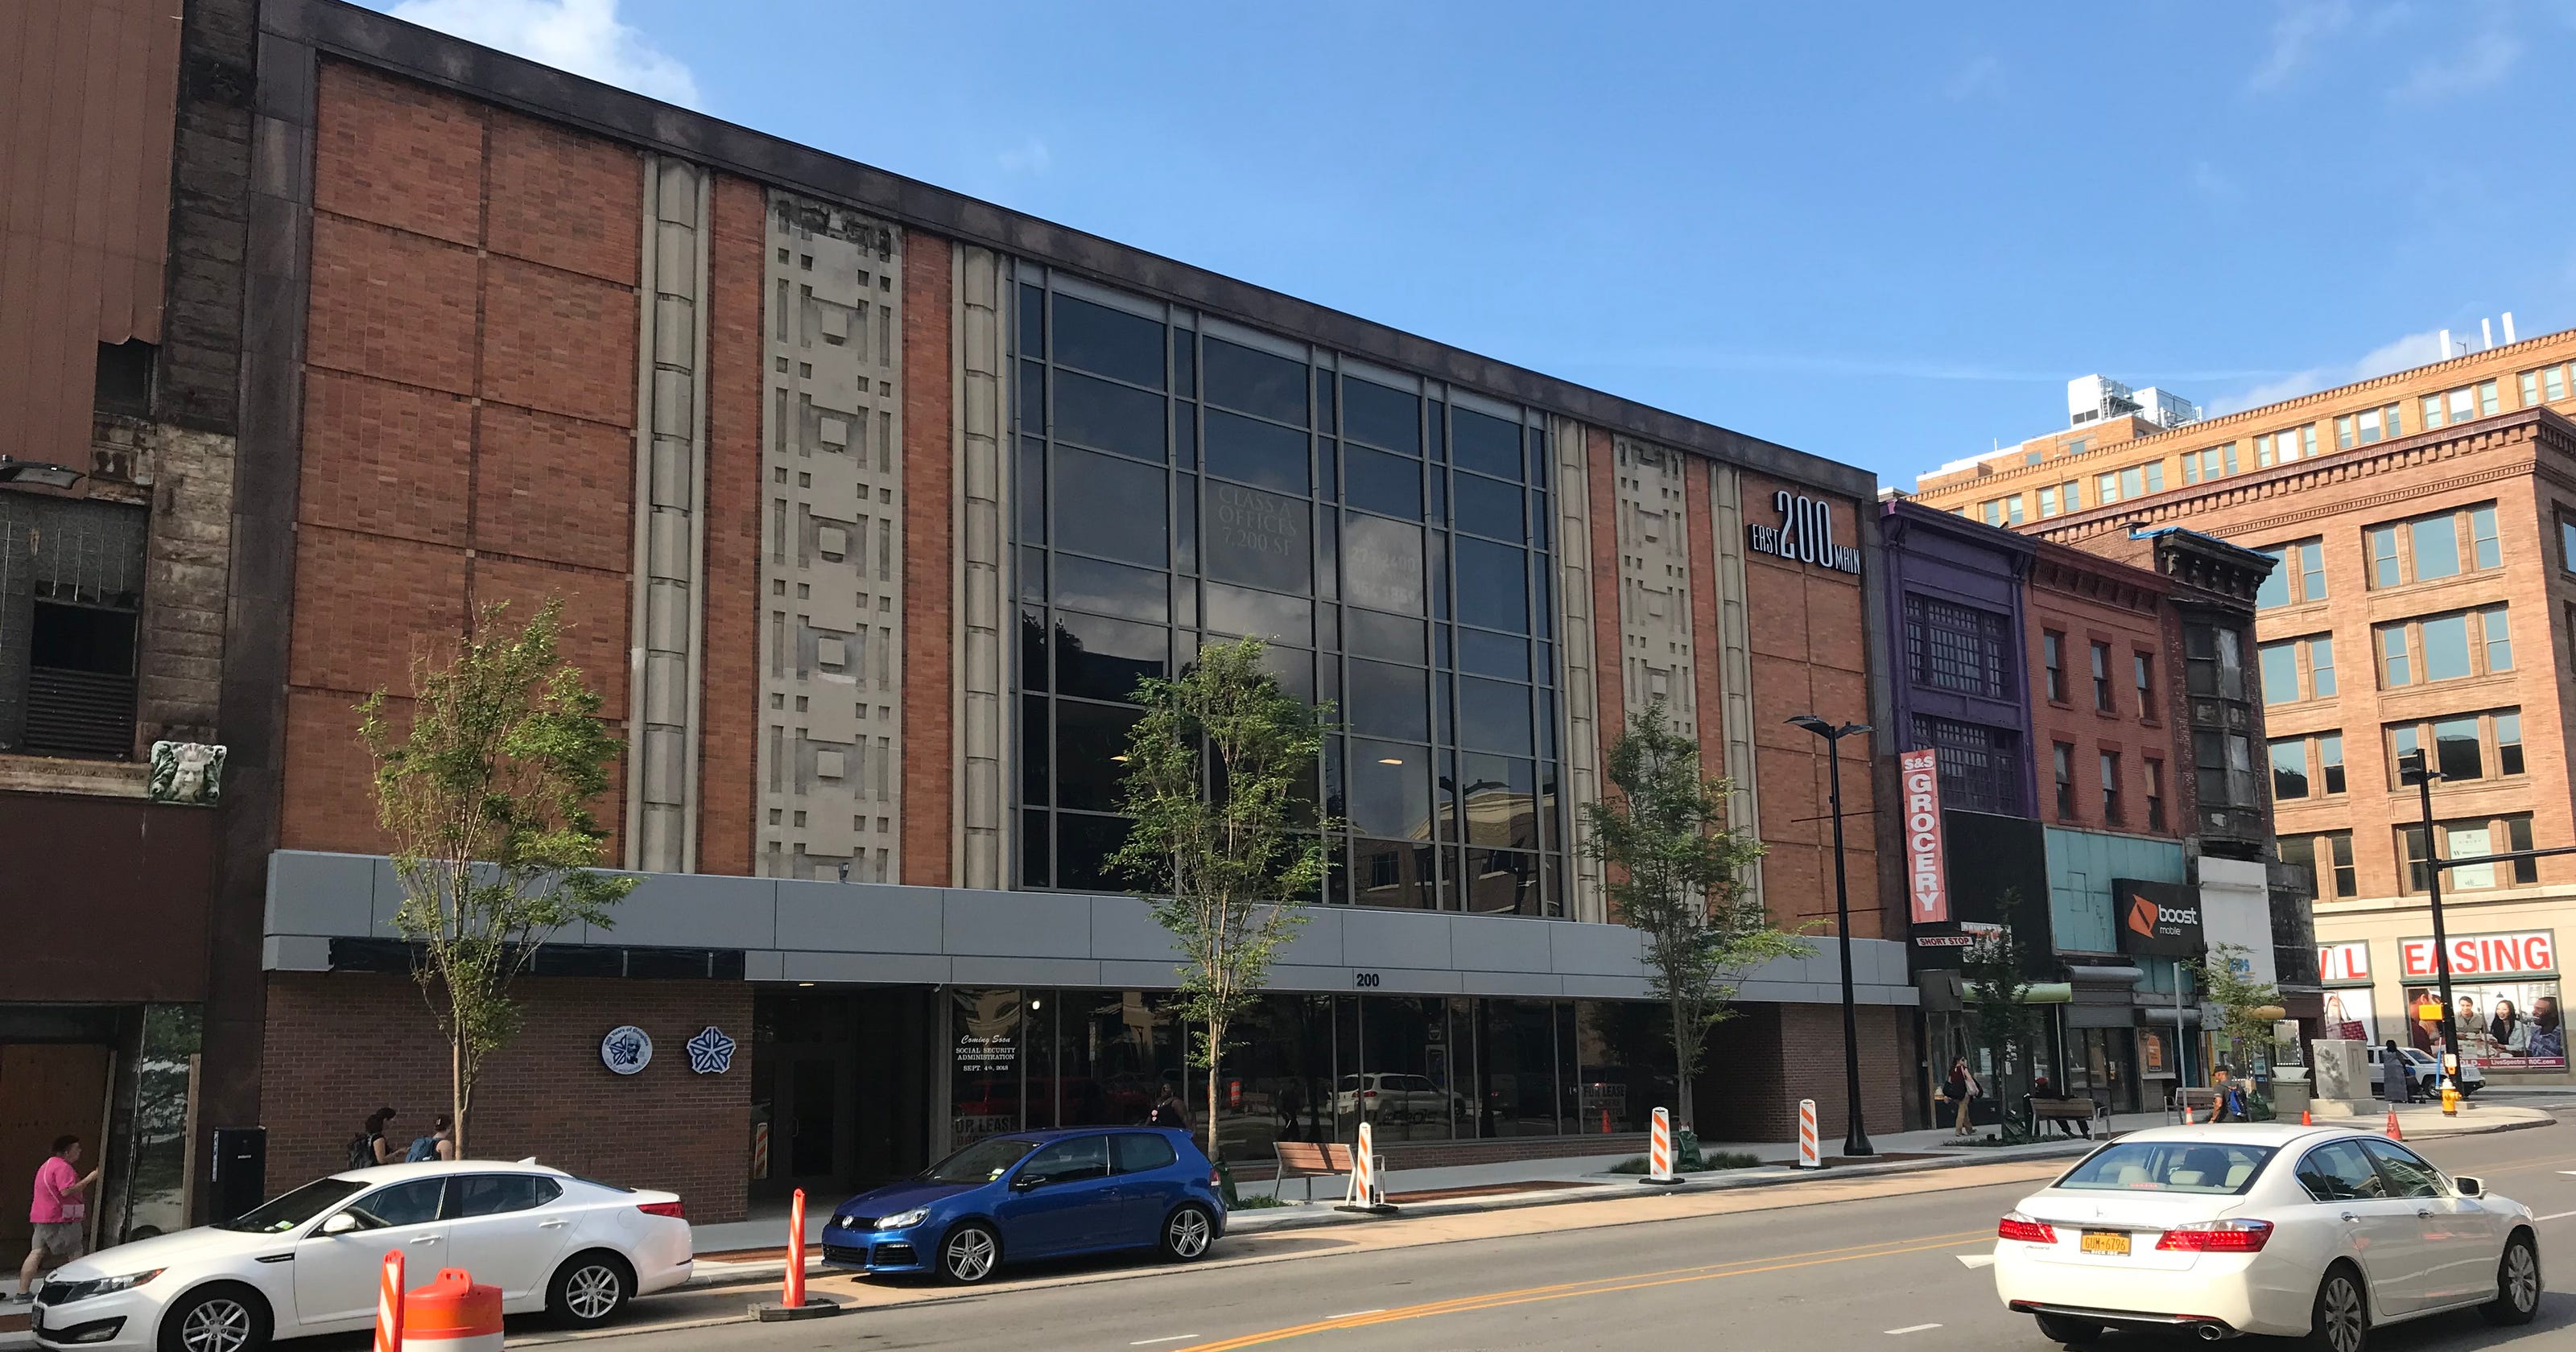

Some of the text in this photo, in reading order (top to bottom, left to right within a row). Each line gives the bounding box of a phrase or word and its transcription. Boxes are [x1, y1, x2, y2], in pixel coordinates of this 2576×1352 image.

[1218, 484, 1291, 518] CLASS A
[1218, 504, 1297, 538] OFFICES
[1752, 489, 1861, 575] EAST 200 MAIN
[1904, 755, 1934, 771] S&S
[1908, 773, 1940, 911] GROCERY
[2158, 904, 2198, 925] boost
[2160, 926, 2181, 936] mobile
[1920, 937, 1969, 946] SHORT STOP
[1356, 973, 1380, 987] 200
[960, 1034, 1011, 1045] Coming Soon
[955, 1119, 974, 1133] OR
